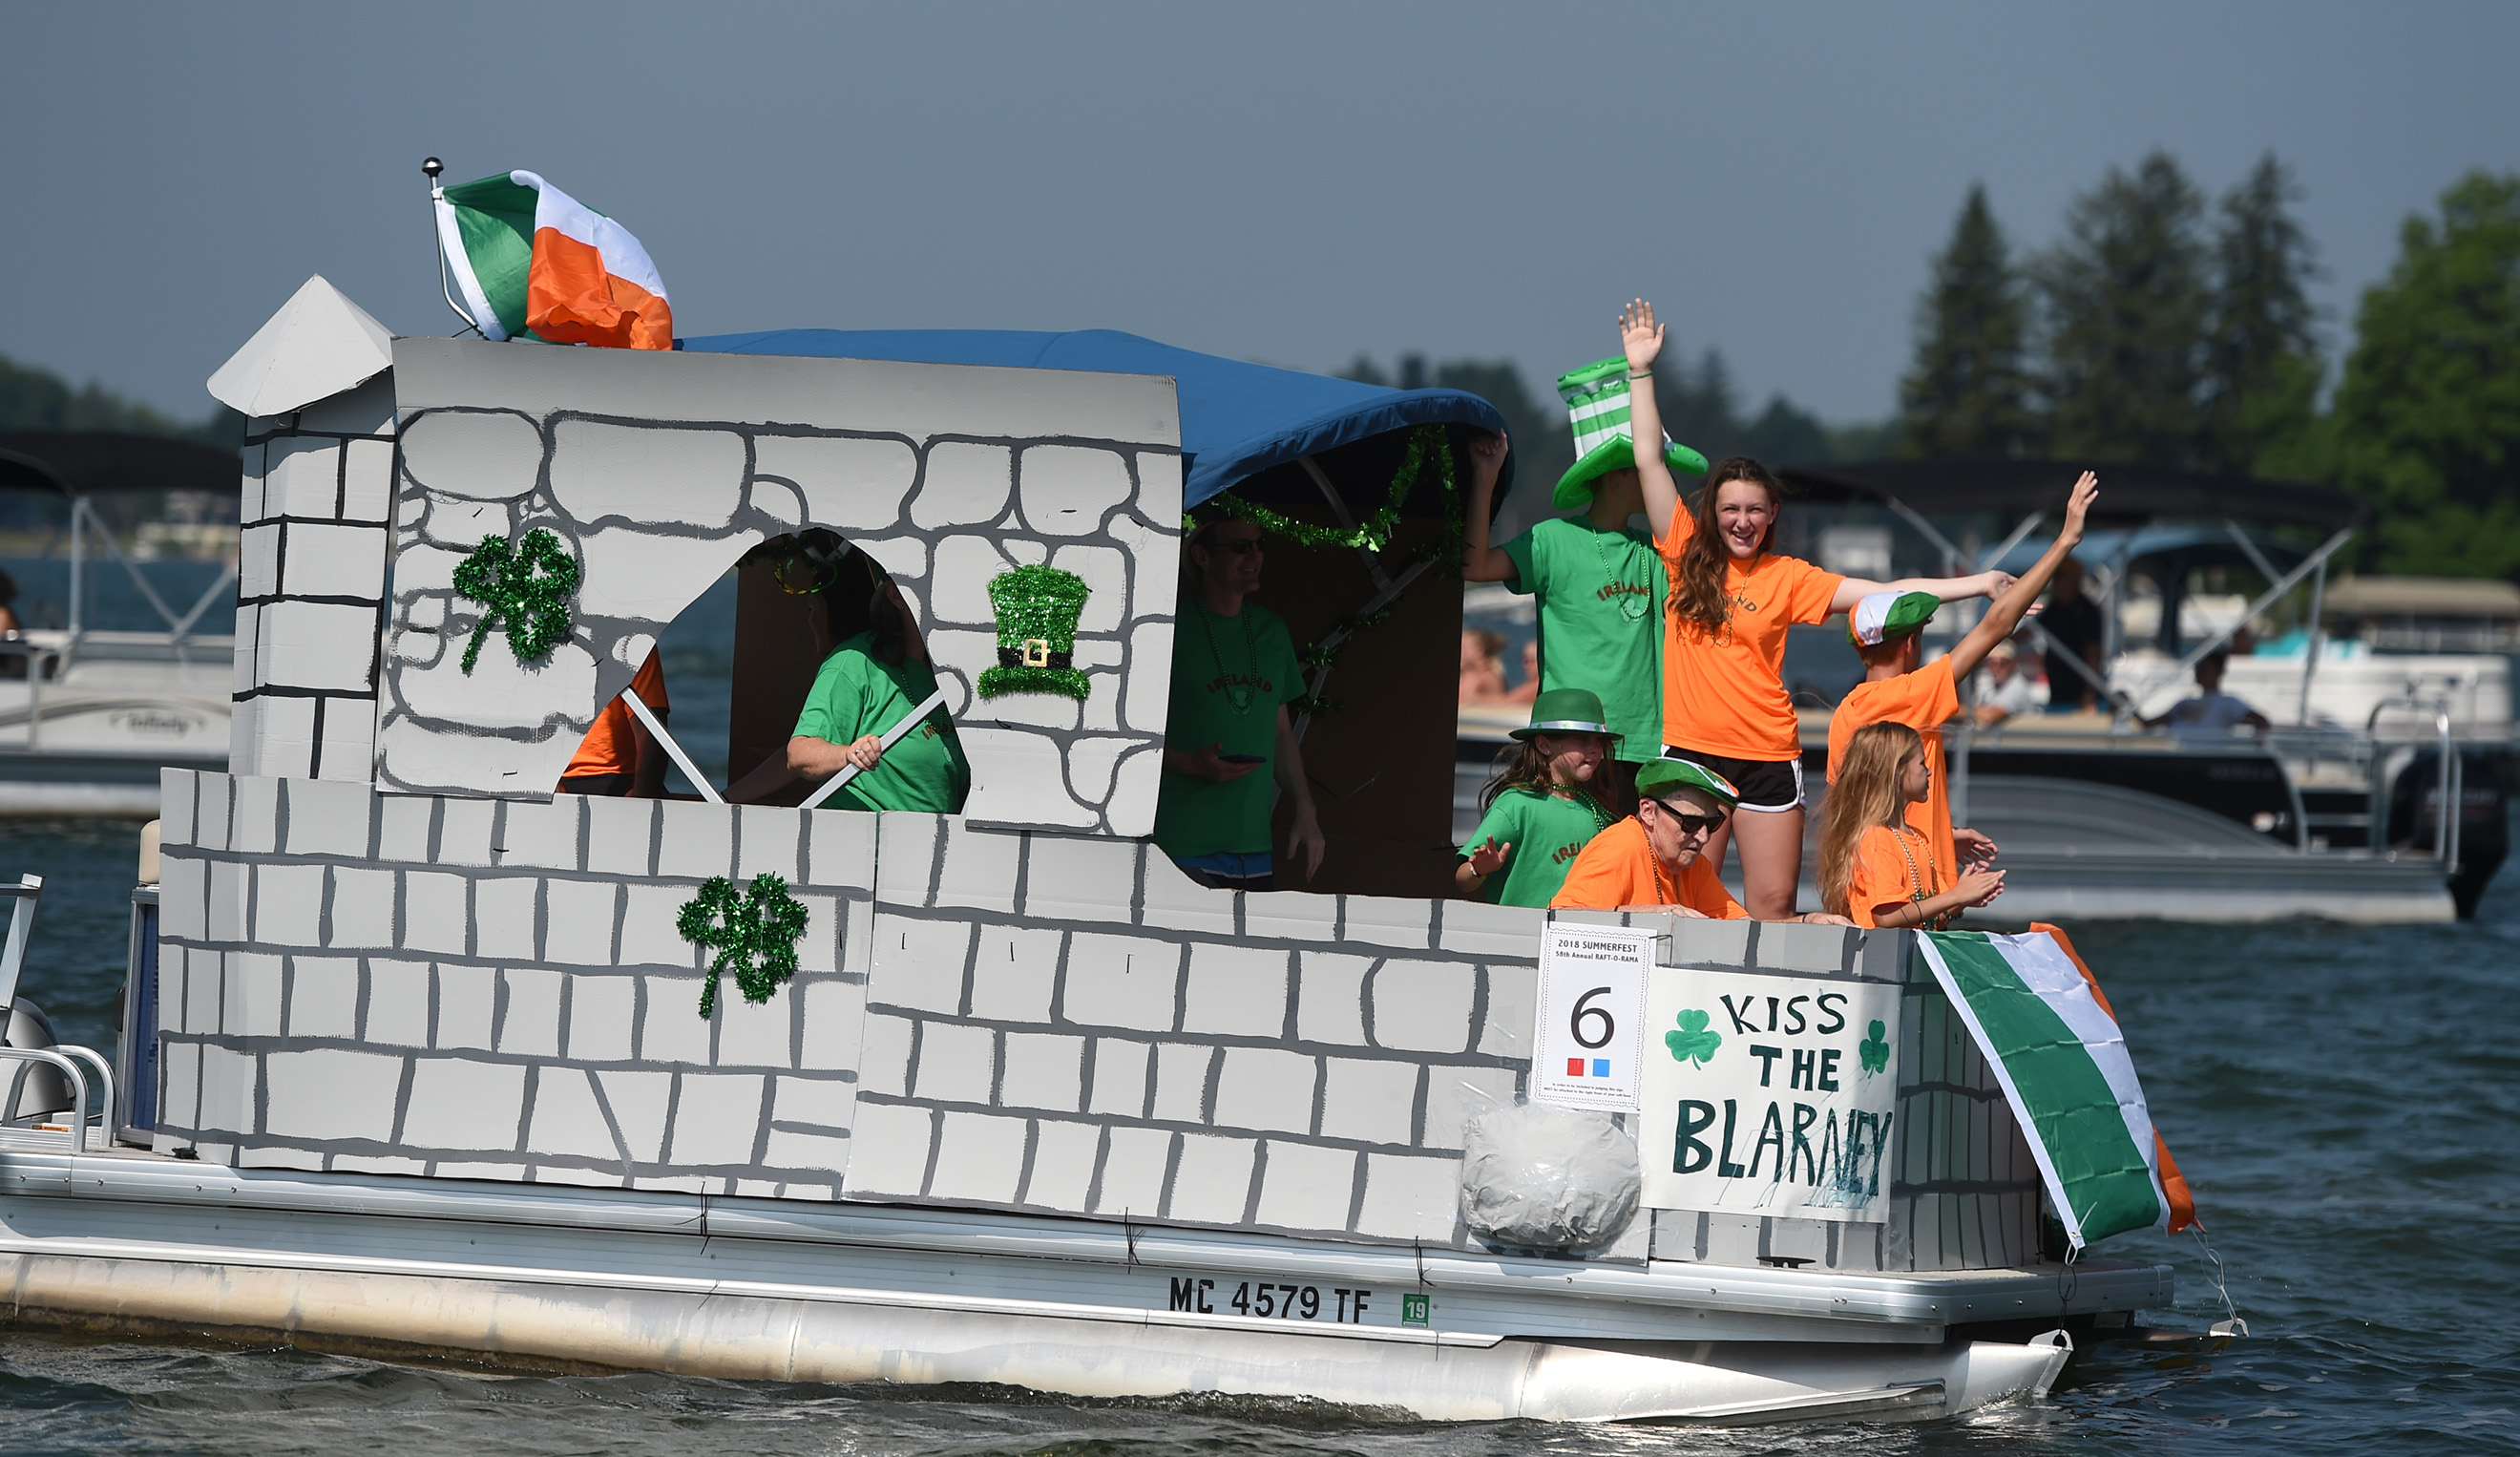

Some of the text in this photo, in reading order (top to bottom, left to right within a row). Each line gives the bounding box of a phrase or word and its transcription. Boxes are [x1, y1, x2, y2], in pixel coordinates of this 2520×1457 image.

[1596, 581, 1648, 602] IRELAN
[1552, 842, 1582, 864] IREL
[1558, 940, 1637, 953] 2018 SUMMERFEST
[1595, 954, 1639, 962] RAFT-O-RAMA
[1570, 986, 1615, 1049] 6
[1719, 993, 1848, 1036] KISS
[1749, 1044, 1842, 1092] THE
[1672, 1098, 1893, 1196] BLARNEY
[1169, 1277, 1372, 1323] MC 4579 TF
[1407, 1301, 1426, 1319] 19
